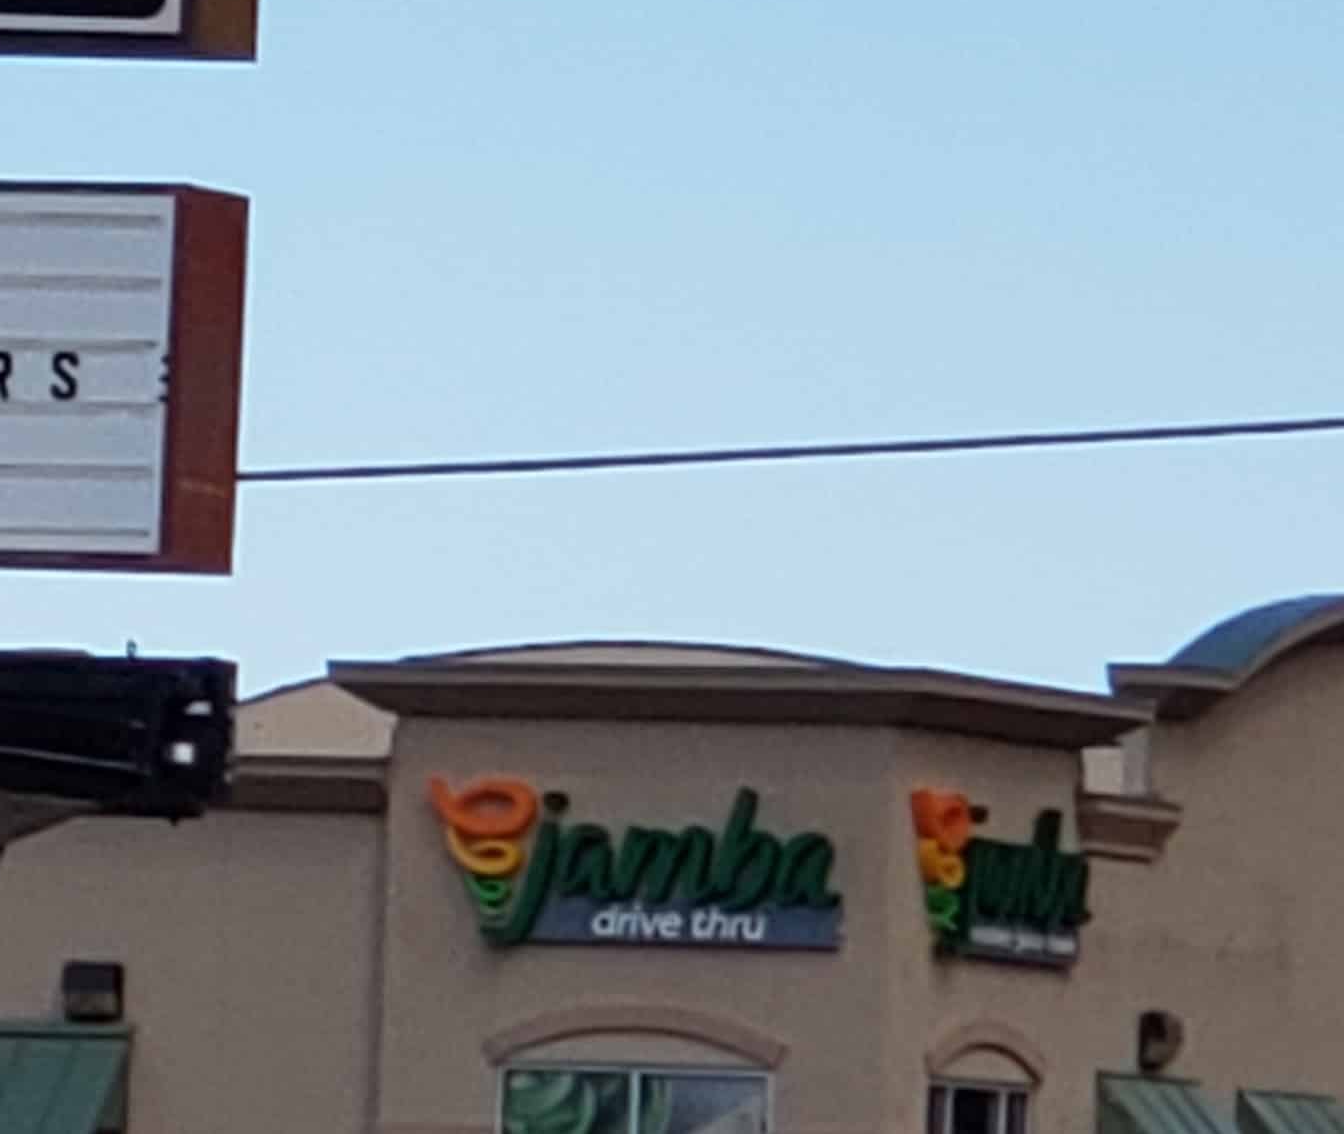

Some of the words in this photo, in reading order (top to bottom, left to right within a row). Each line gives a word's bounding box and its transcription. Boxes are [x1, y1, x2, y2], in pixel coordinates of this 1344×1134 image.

[494, 785, 844, 945] jamba
[590, 904, 683, 940] drive
[690, 907, 768, 942] thru
